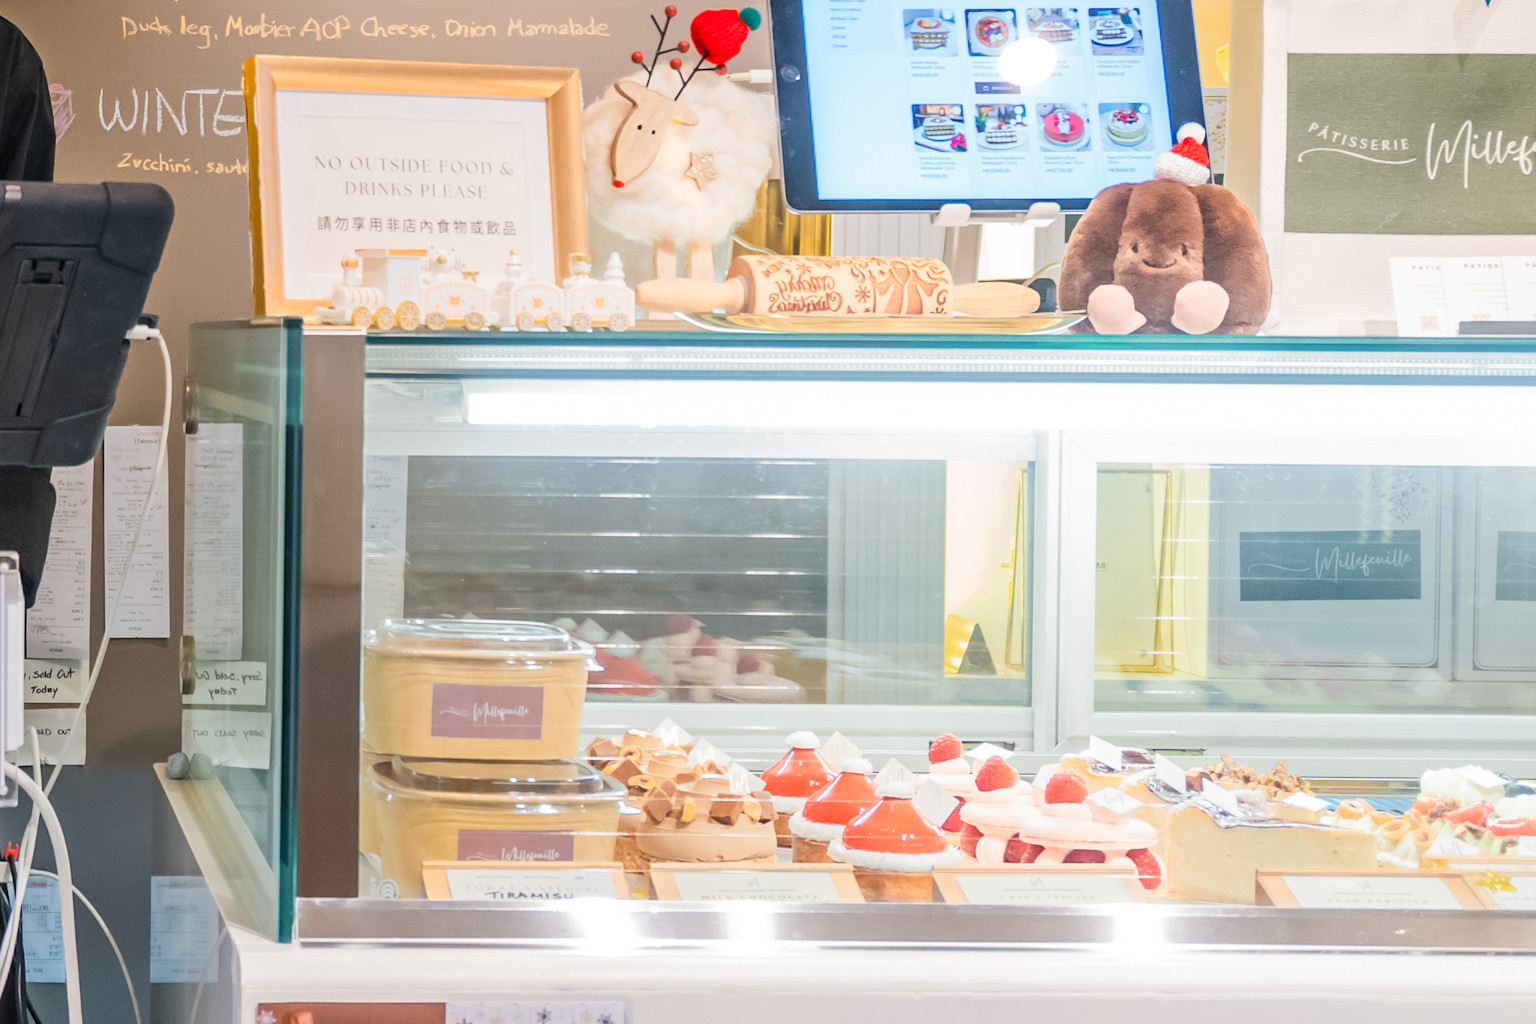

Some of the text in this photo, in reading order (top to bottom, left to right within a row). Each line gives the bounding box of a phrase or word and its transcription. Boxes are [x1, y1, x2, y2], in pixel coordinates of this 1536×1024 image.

[122, 15, 172, 39] Duck
[226, 13, 296, 39] Morbier
[444, 18, 497, 38] Onion
[507, 17, 611, 38] Marmalade
[314, 155, 514, 176] NO OUTSIDE FOOD &
[345, 181, 489, 200] DRINKS PLEASE
[1315, 545, 1413, 583] Millefeuille
[56, 669, 76, 679] Out
[30, 685, 59, 699] Today
[472, 702, 530, 724] Millefeuille
[36, 728, 72, 736] OLD OUT
[484, 891, 575, 900] TIRAMISU
